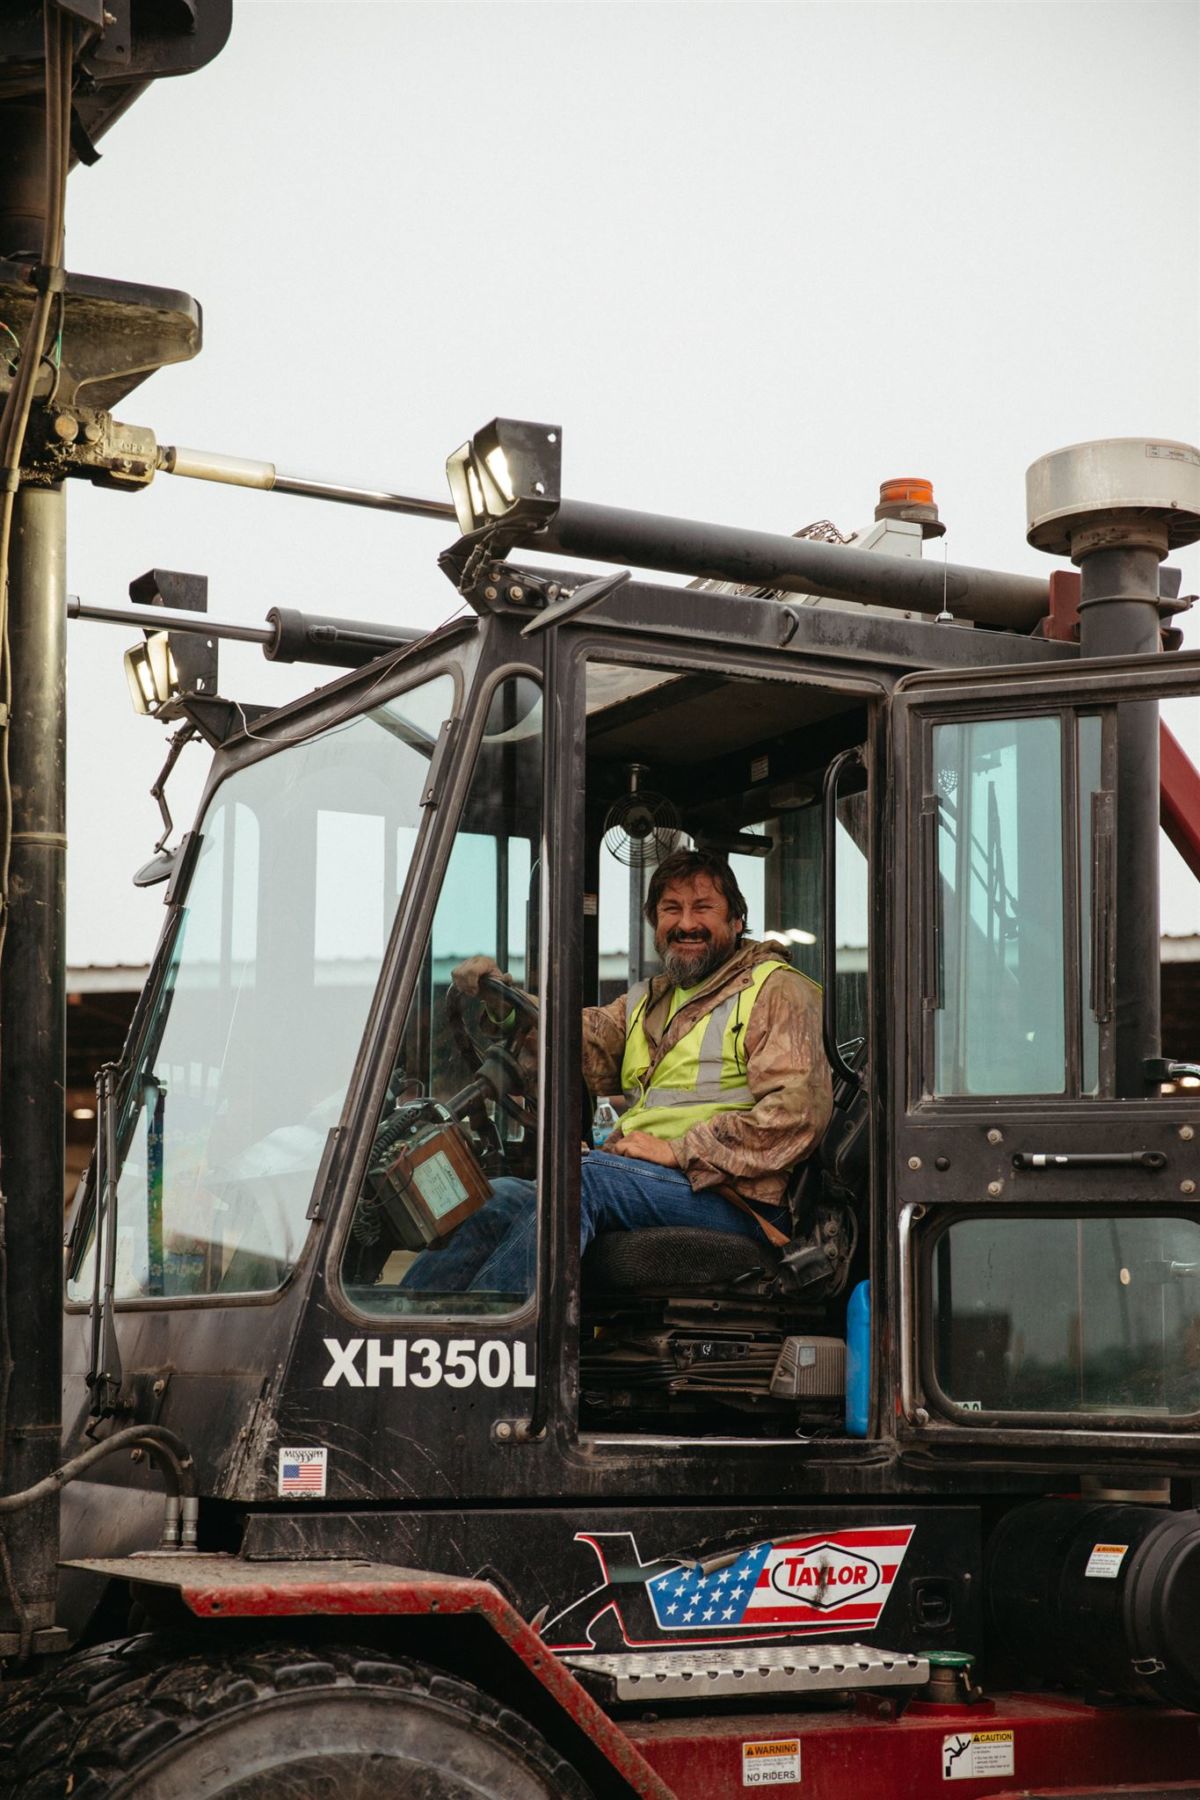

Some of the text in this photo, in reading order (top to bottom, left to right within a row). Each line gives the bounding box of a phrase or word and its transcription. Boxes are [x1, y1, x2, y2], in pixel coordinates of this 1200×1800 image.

[322, 1338, 536, 1388] XH350L
[784, 1557, 868, 1587] TAYLOR
[980, 1733, 1012, 1742] CAUTION
[754, 1743, 797, 1755] WARNING
[746, 1770, 796, 1782] NO RIDERS
